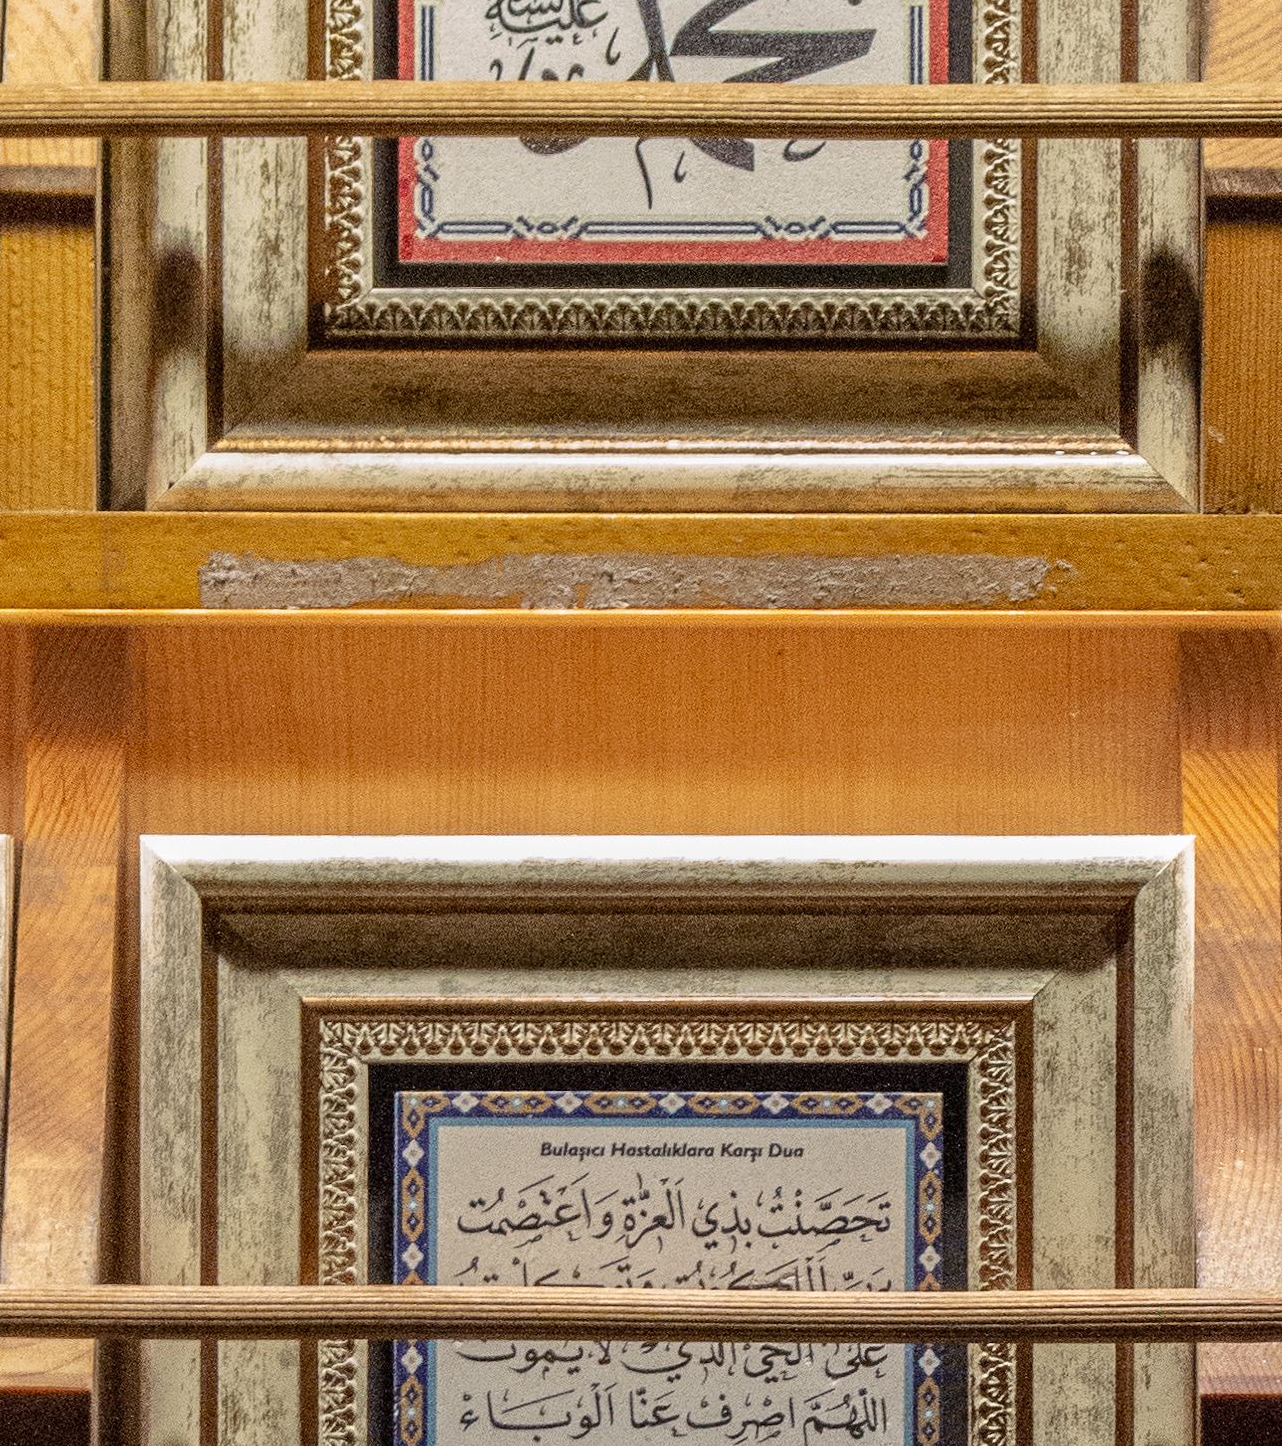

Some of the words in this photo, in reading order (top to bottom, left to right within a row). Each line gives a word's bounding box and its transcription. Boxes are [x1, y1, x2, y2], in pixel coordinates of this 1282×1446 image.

[540, 1142, 606, 1162] Bulaşıcı
[610, 1142, 716, 1158] Hastalıklara
[720, 1142, 763, 1163] Karşı
[768, 1142, 805, 1158] Dua
